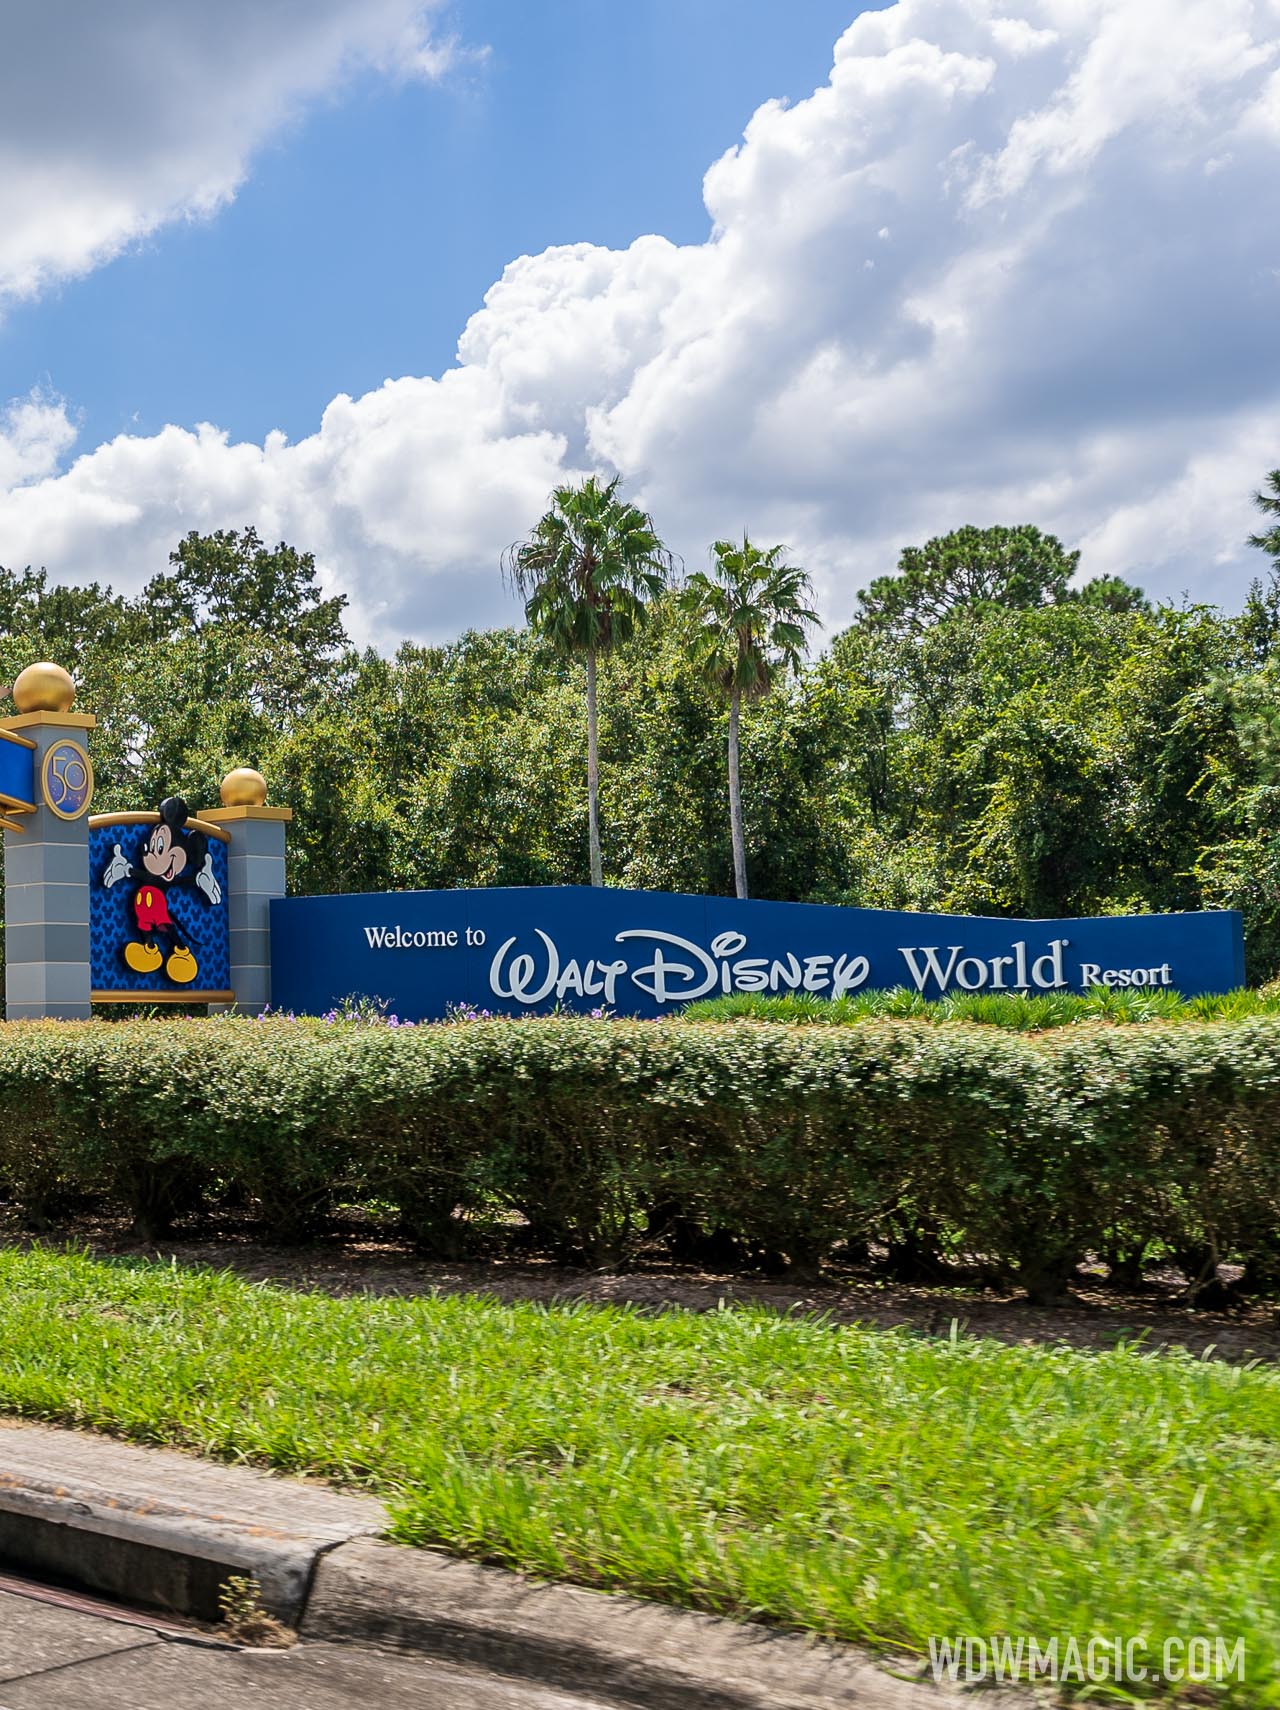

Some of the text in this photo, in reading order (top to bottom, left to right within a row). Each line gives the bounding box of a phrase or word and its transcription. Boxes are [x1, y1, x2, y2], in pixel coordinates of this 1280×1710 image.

[52, 756, 87, 805] 50
[363, 925, 486, 949] Welcome to
[1080, 963, 1173, 987] Resort
